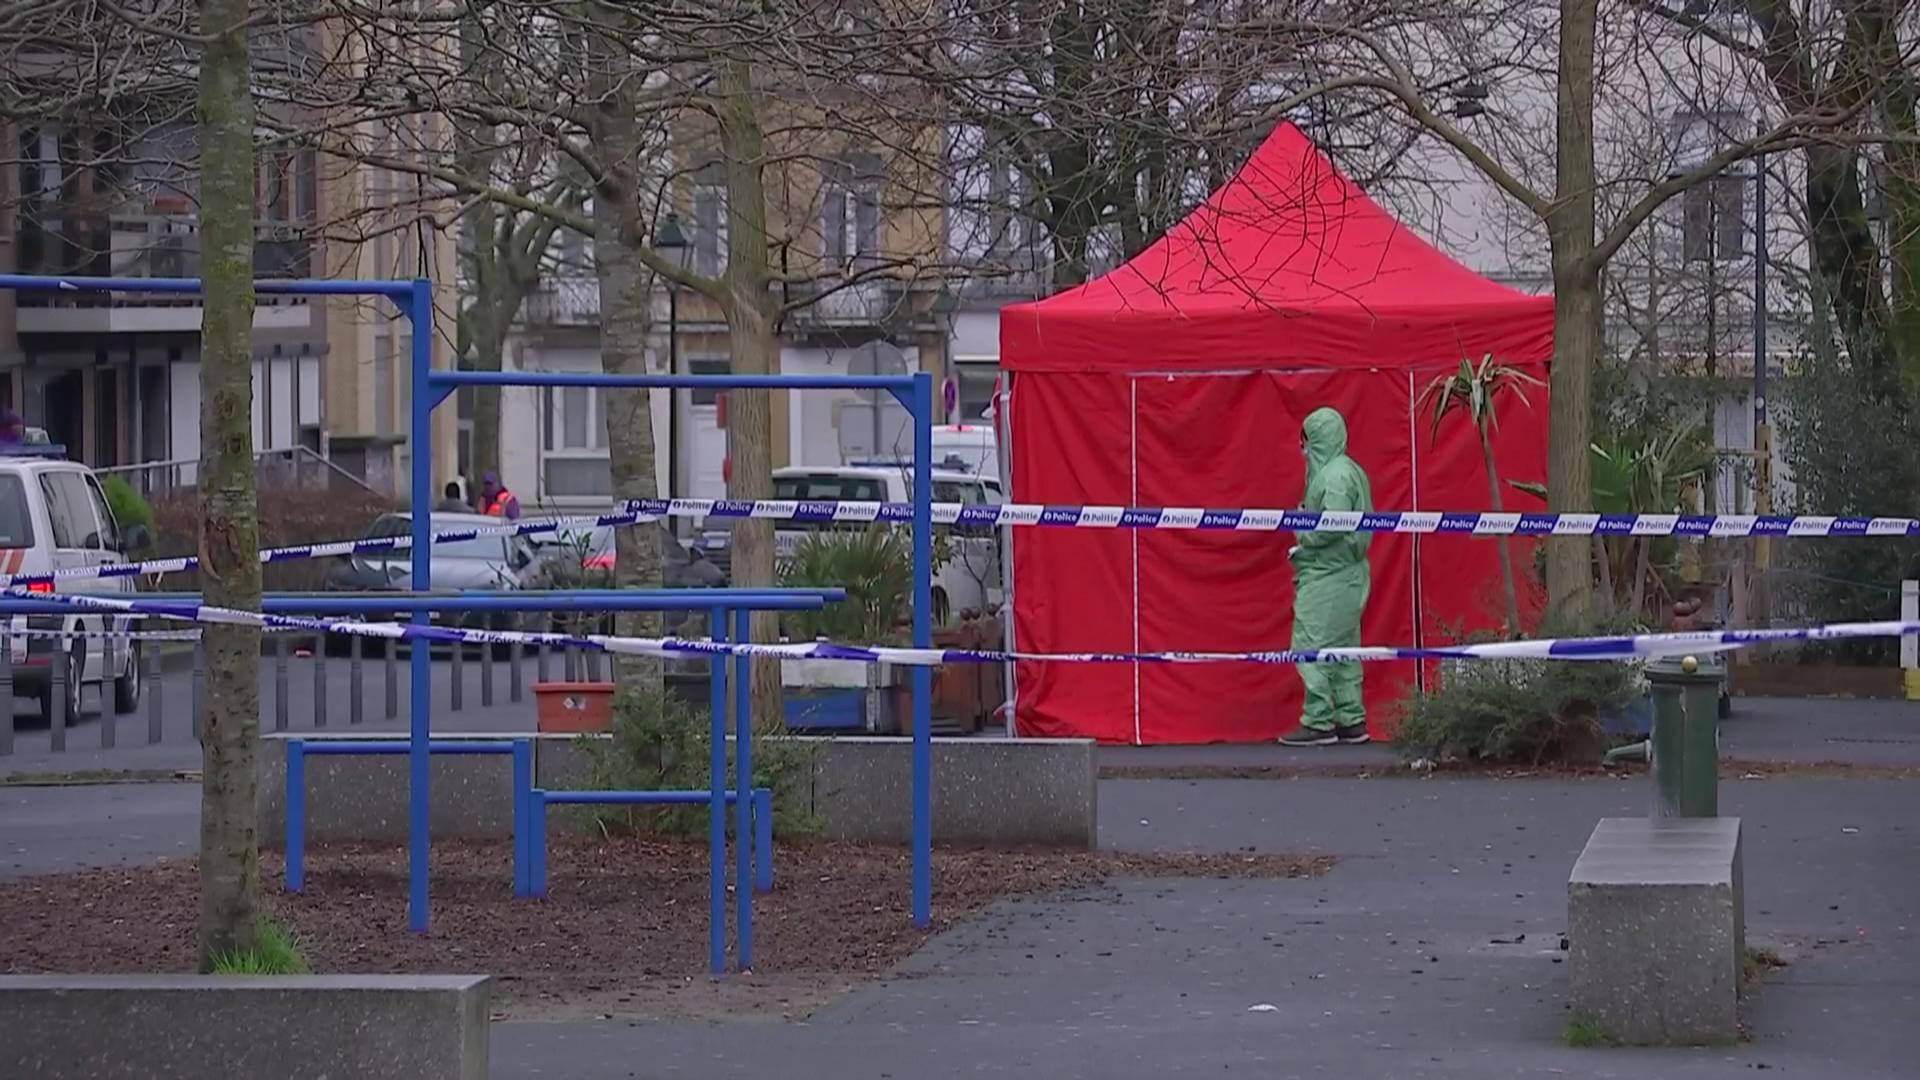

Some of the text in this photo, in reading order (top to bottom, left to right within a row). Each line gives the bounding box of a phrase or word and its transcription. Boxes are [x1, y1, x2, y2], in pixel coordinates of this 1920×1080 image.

[641, 501, 667, 509] Police
[682, 501, 711, 510] Politie
[725, 502, 751, 511] Police
[766, 503, 794, 513] Politie
[808, 504, 833, 514] Police
[850, 505, 876, 515] Politie
[890, 506, 914, 516] Police
[972, 509, 997, 520] Police
[1011, 511, 1038, 521] Politie
[1052, 512, 1077, 522] Police
[1091, 513, 1118, 523] Politie
[1133, 514, 1157, 524] Police
[1172, 514, 1198, 524] Politie
[1213, 515, 1237, 525] Police
[1252, 516, 1277, 526] Politie
[1292, 517, 1316, 527] Police
[1331, 517, 1356, 527] Politie
[1371, 518, 1395, 528] Police
[1410, 518, 1435, 528] Politie
[1450, 519, 1474, 528] Police
[1488, 519, 1514, 529] Politie
[1529, 519, 1552, 529] Police
[1567, 519, 1593, 529] Politie
[1607, 520, 1631, 530] Police
[1646, 520, 1671, 530] Politie
[1686, 521, 1709, 530] Police
[1724, 520, 1749, 530] Politie
[1764, 521, 1788, 530] Police
[1802, 520, 1828, 529] Politie
[1841, 520, 1866, 529] Police
[1880, 520, 1905, 529] Politie
